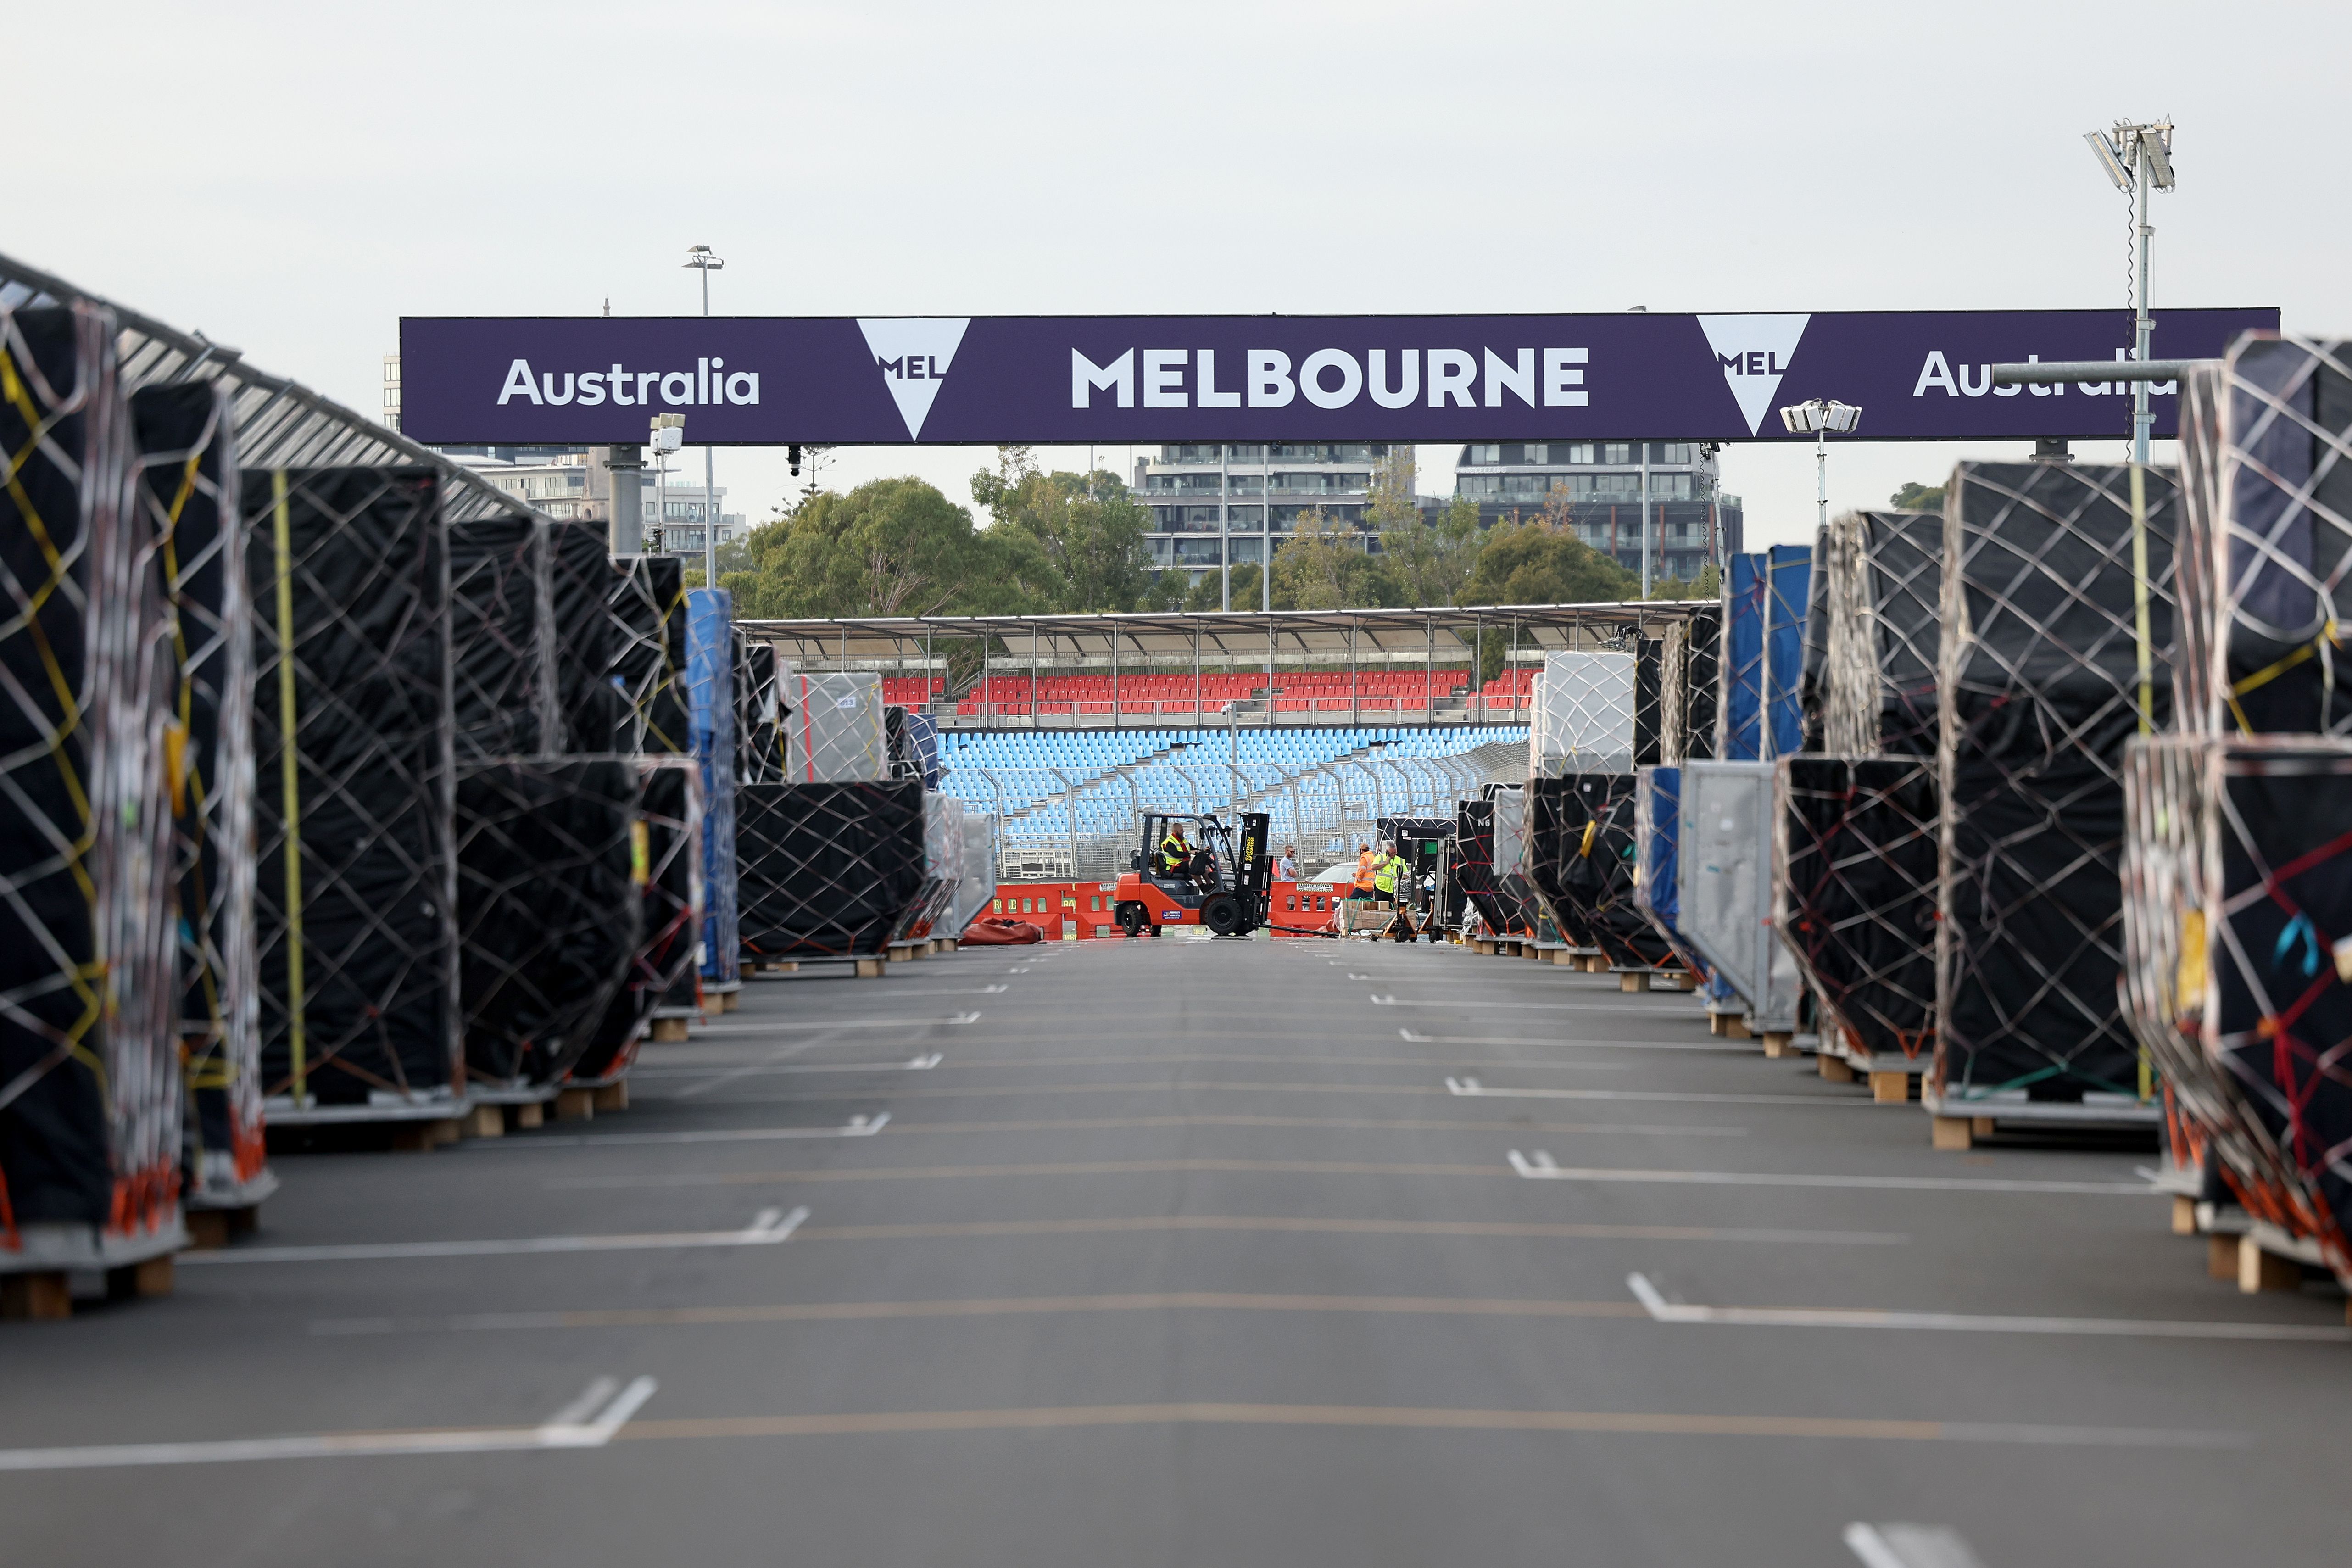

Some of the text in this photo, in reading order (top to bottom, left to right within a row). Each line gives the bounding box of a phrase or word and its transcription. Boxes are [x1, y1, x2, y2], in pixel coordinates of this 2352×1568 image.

[878, 355, 946, 379] MEL
[1071, 346, 1589, 409] MELBOURNE
[1718, 351, 1785, 375] MEL
[1912, 348, 2177, 397] Austl
[497, 357, 760, 406] Australia
[1478, 818, 1491, 827] N6
